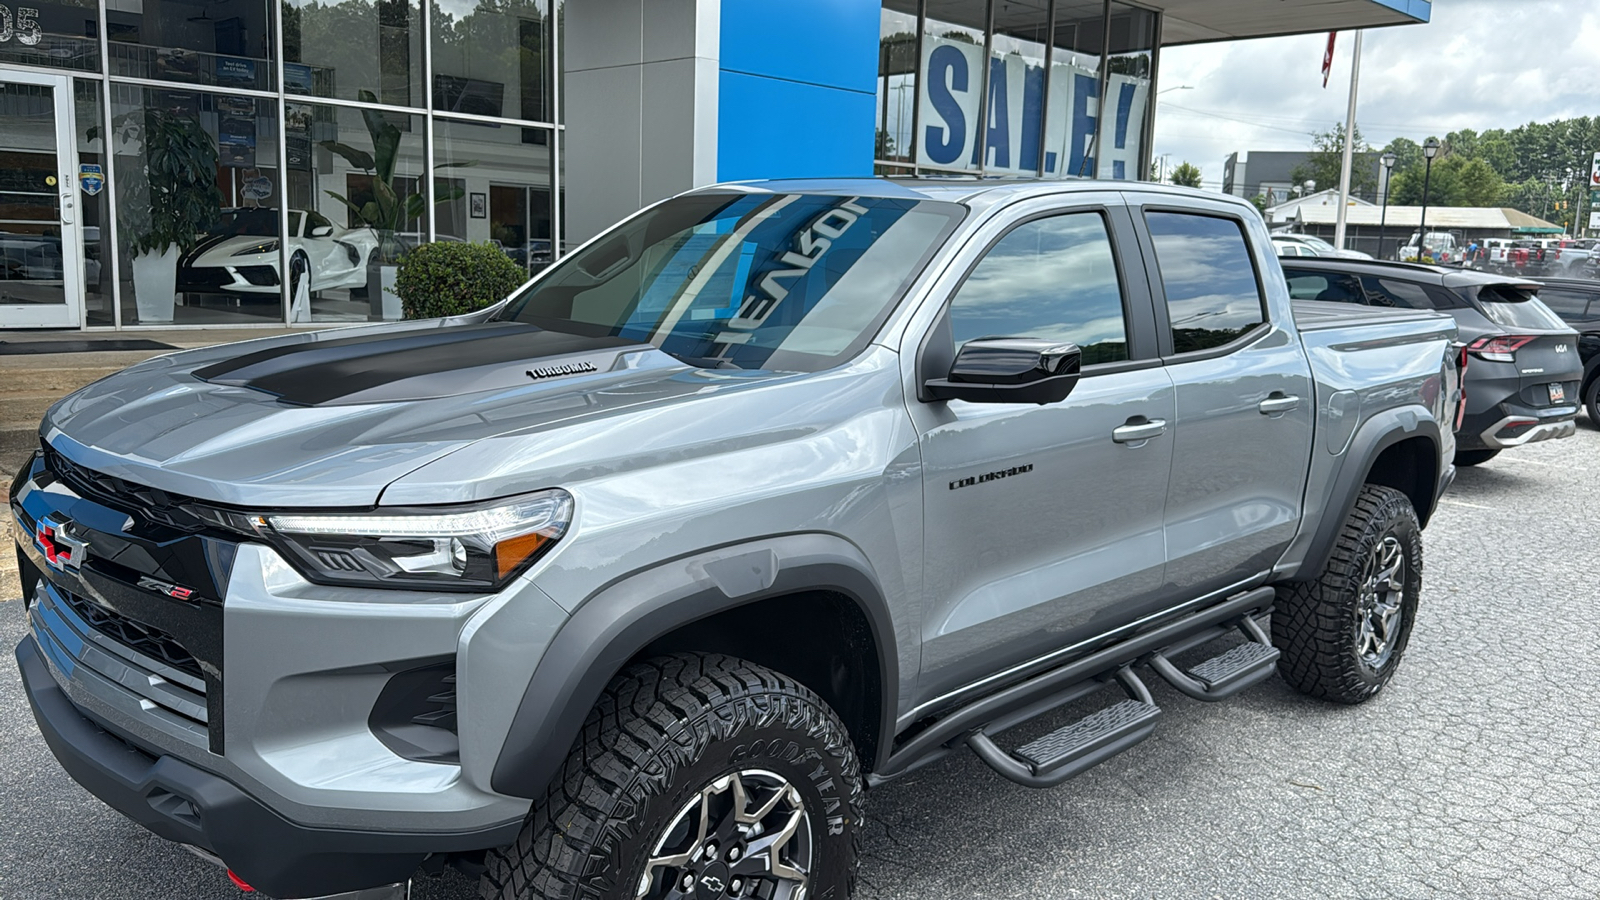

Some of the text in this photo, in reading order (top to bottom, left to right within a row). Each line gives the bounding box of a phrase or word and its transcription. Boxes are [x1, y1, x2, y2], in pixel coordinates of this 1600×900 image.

[925, 45, 1137, 180] SALE!
[526, 361, 597, 380] TURBOMAX
[949, 463, 1034, 491] COLORADO
[136, 576, 193, 601] ZR2
